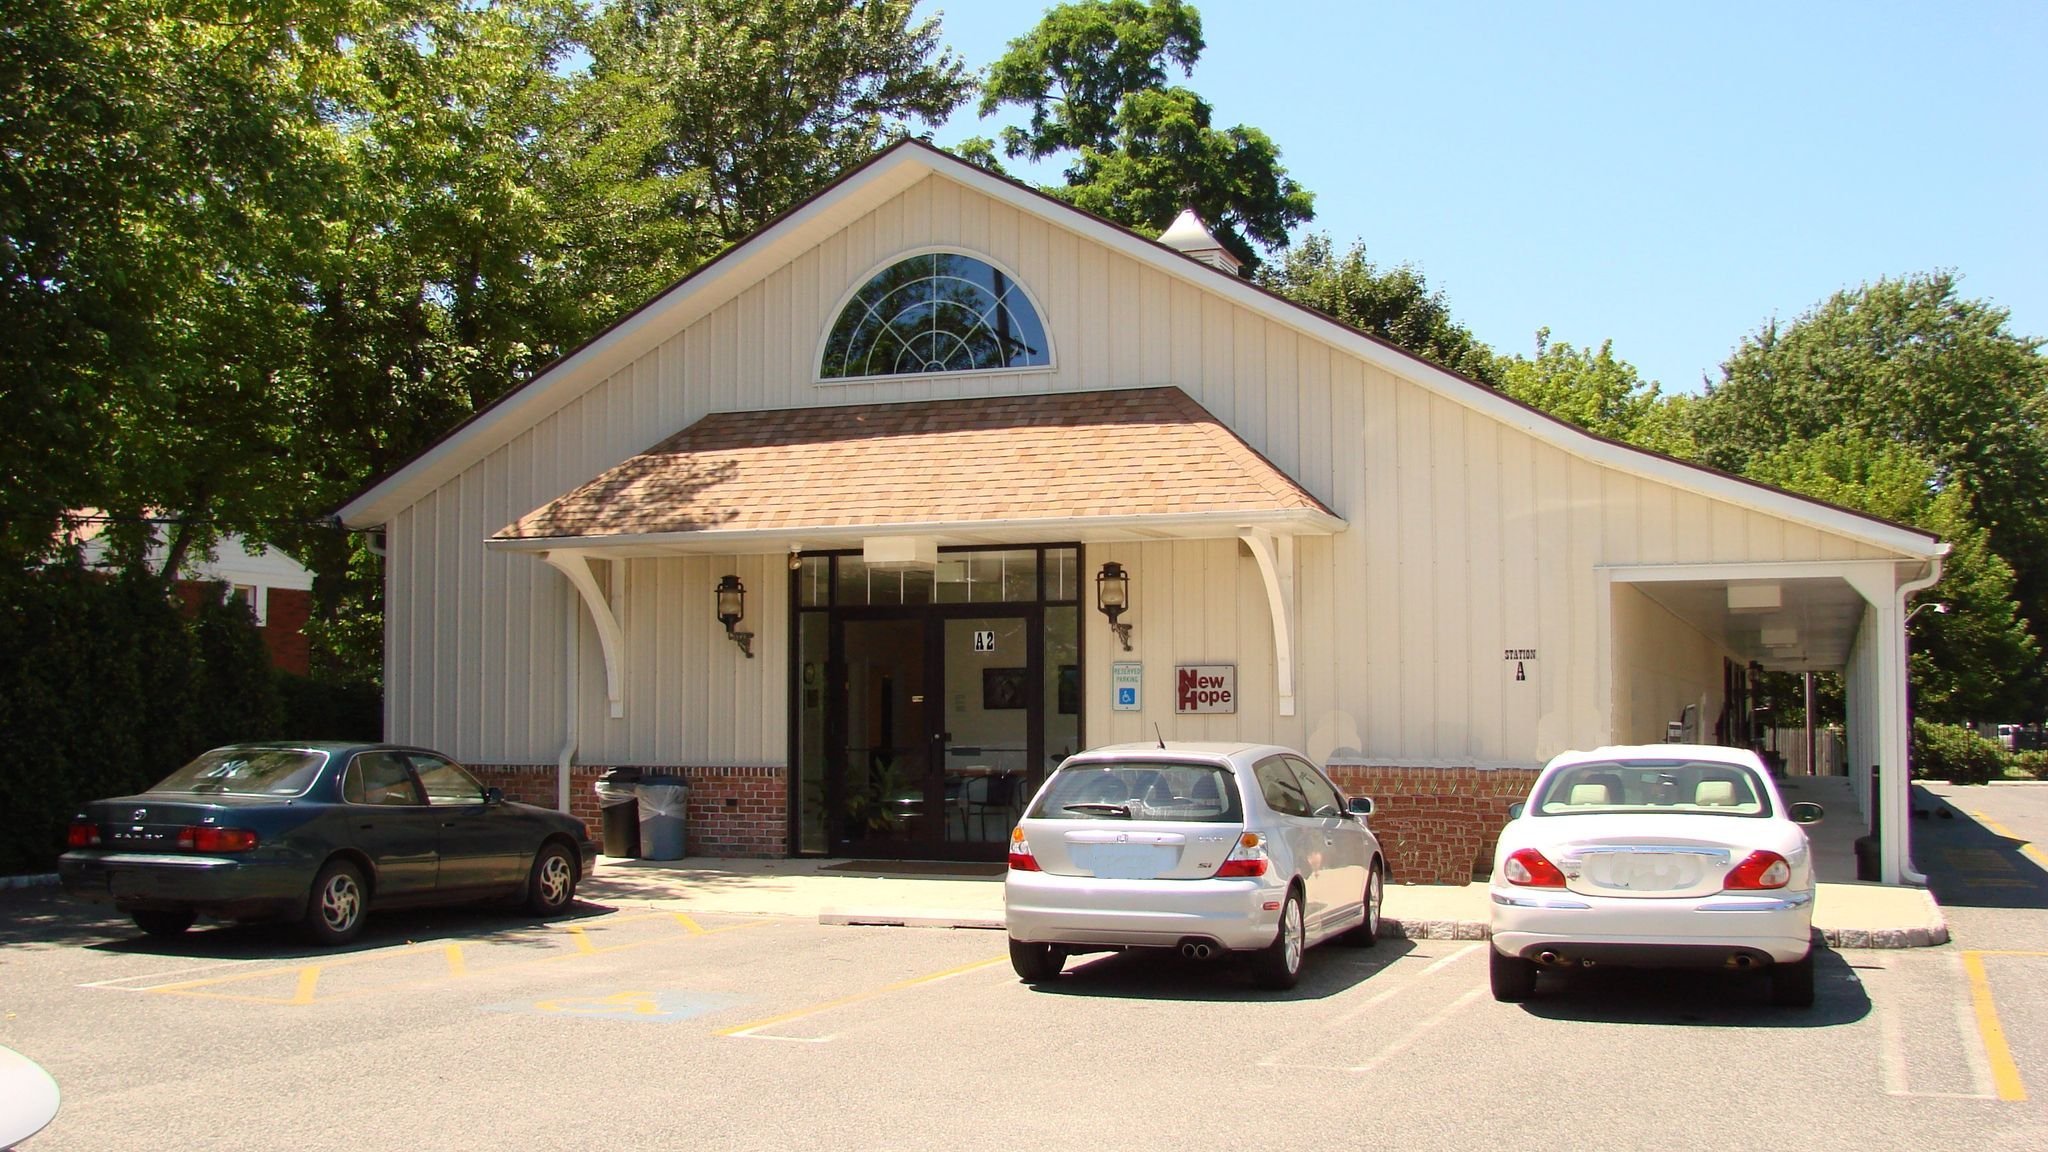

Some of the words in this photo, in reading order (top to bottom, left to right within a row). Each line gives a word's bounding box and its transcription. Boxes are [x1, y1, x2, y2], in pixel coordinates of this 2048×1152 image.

[976, 632, 993, 650] A2
[1505, 649, 1536, 660] STATION
[1179, 669, 1224, 689] New
[1516, 661, 1525, 681] A
[1178, 689, 1231, 710] Hope
